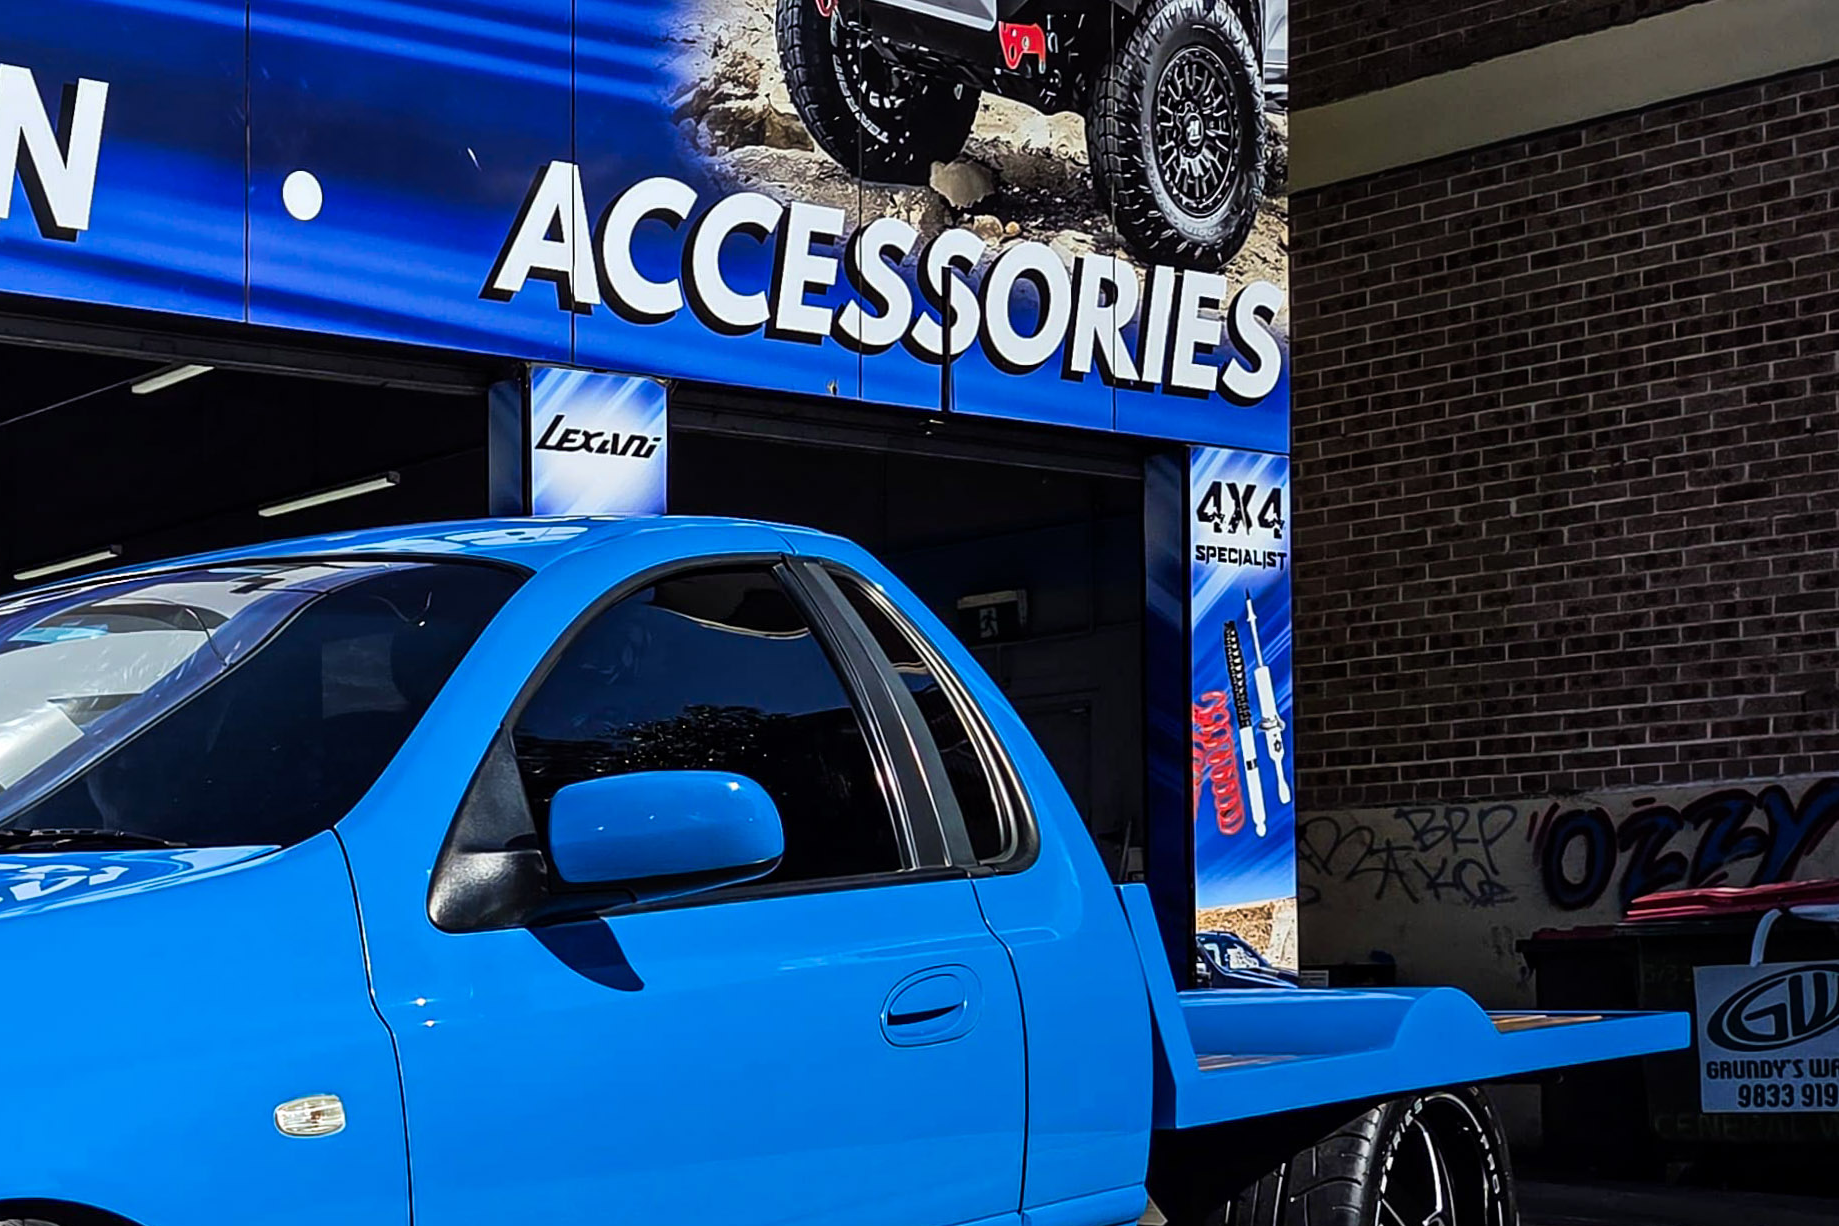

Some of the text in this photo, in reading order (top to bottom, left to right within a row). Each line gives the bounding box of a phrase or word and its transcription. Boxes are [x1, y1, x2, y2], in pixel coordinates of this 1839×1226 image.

[491, 160, 1283, 401] ACCESSORIES
[1196, 481, 1286, 540] 4X4
[1195, 544, 1288, 571] SPECIALIST
[1706, 1058, 1804, 1080] GRUNDY'S
[1737, 1083, 1795, 1108] 9833
